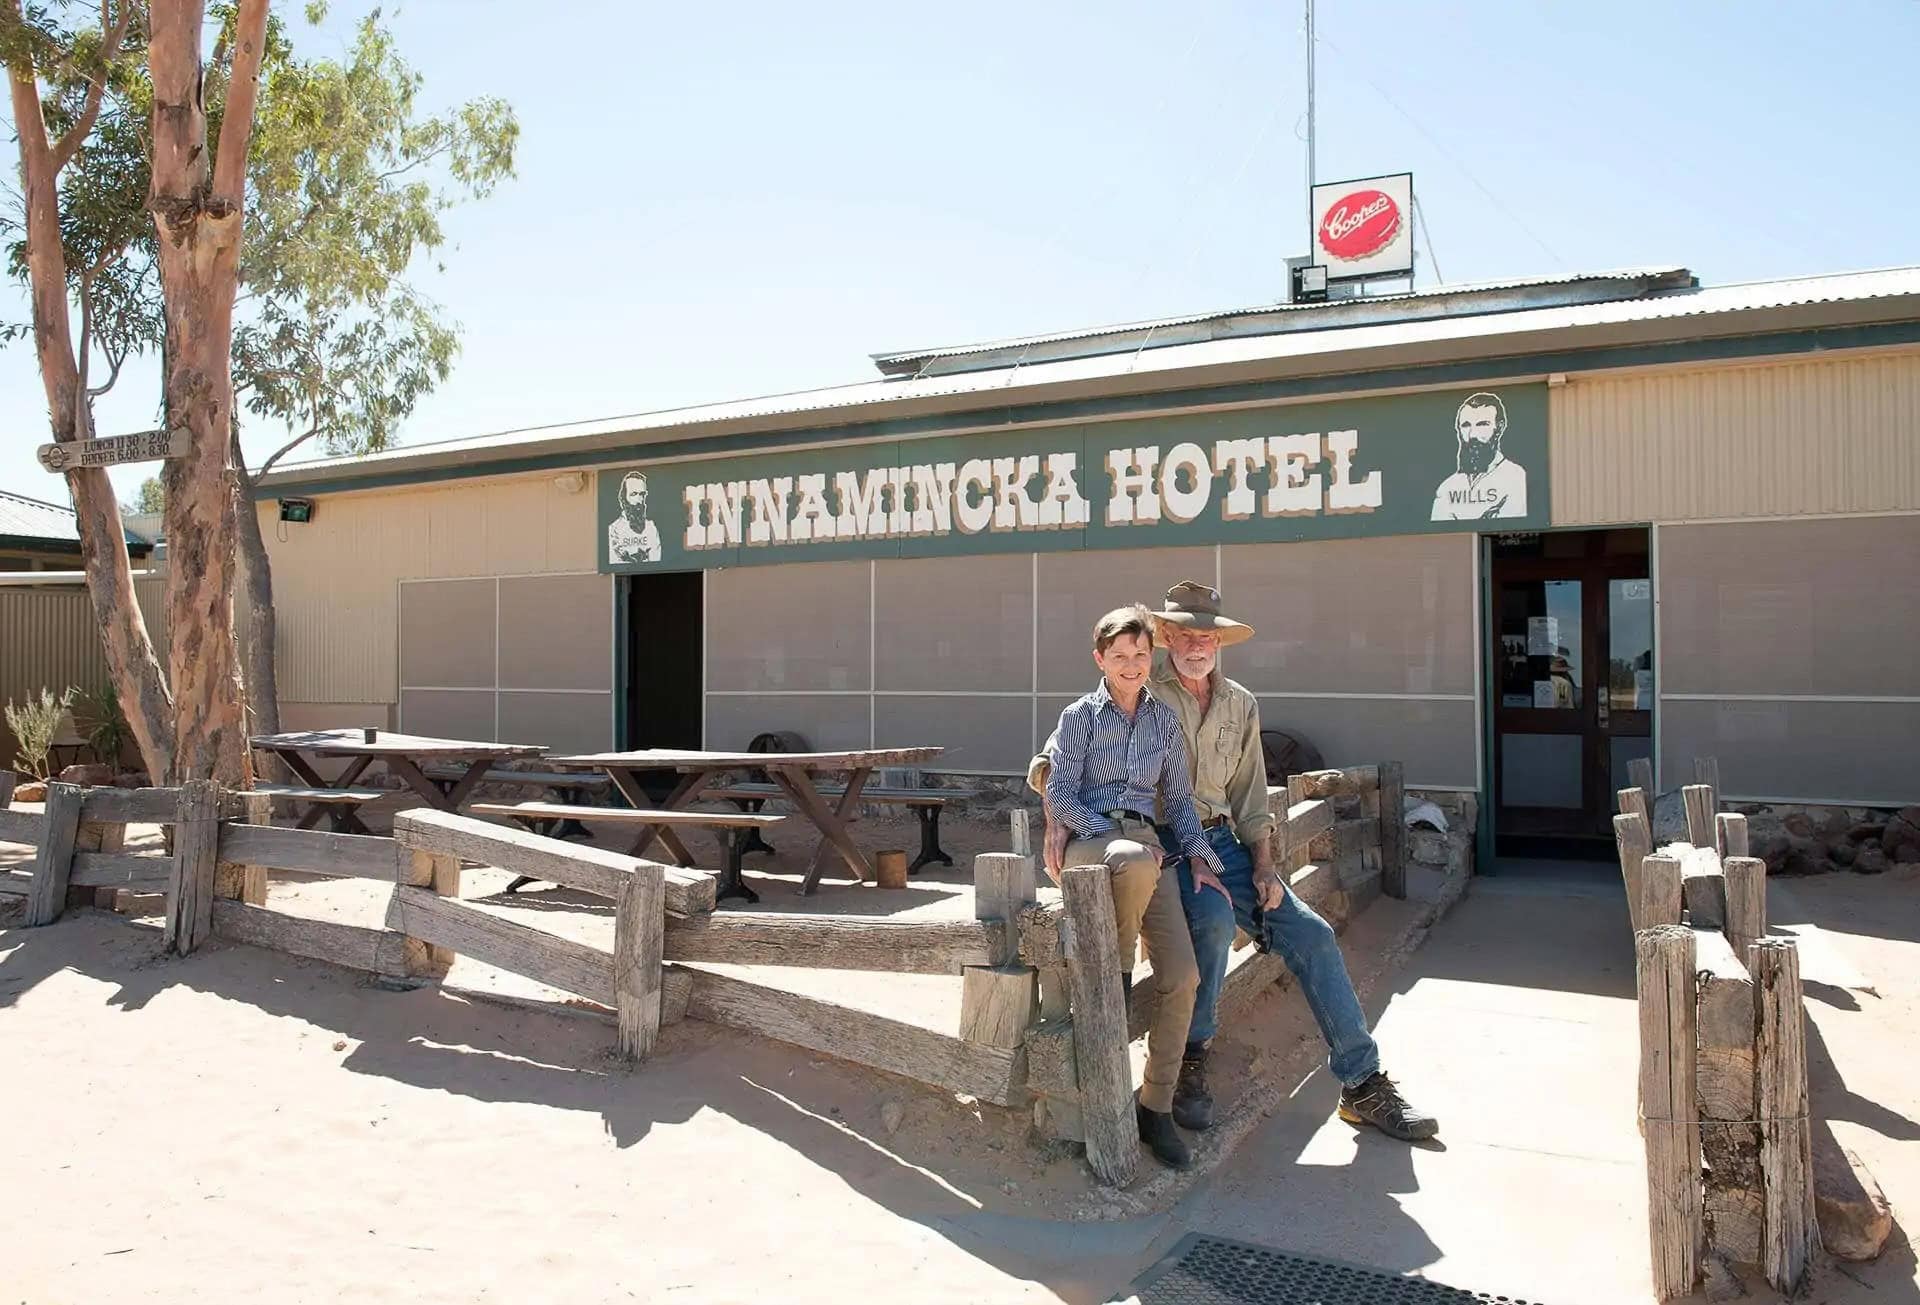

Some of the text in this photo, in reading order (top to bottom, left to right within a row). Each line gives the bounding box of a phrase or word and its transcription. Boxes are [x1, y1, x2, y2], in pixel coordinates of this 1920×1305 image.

[1325, 193, 1390, 241] Coopers
[83, 440, 114, 453] LUNCH
[81, 451, 115, 465] DINNER
[683, 429, 1382, 550] INNAMINCKA HOTEL
[1448, 488, 1498, 504] WILLS
